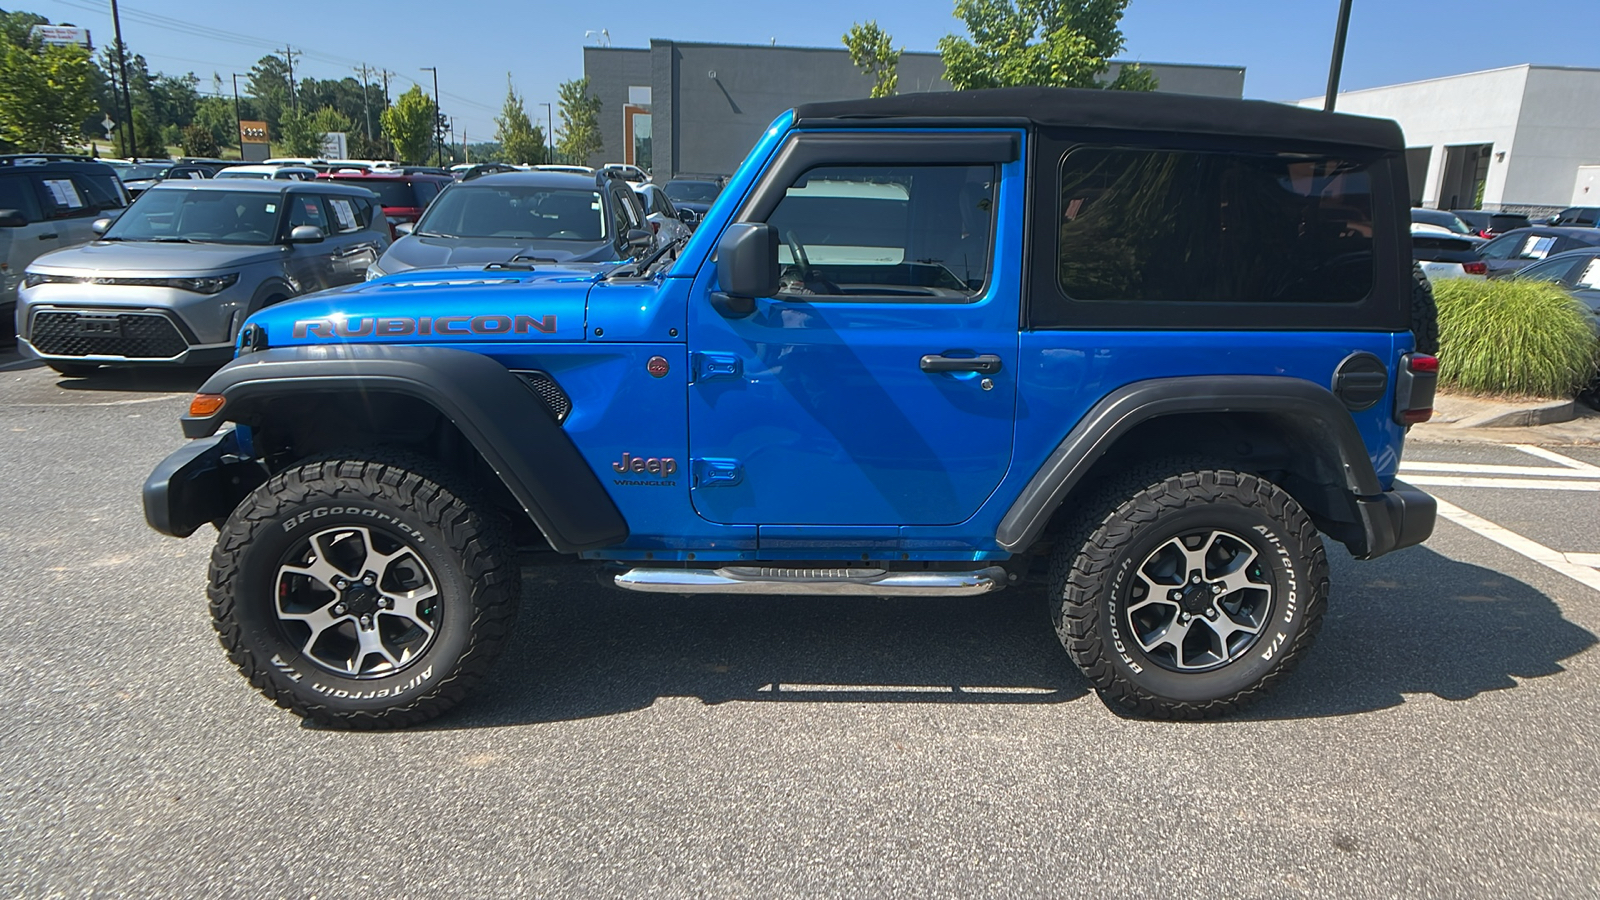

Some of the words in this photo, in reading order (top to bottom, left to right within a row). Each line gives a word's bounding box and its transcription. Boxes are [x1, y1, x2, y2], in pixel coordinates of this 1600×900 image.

[293, 315, 557, 338] RUBICON
[612, 452, 677, 478] Jeep
[282, 506, 425, 542] BFGoodrich
[1252, 524, 1297, 623] All-Terrain
[1108, 558, 1144, 675] BFGoodrich
[1261, 632, 1287, 661] T/A
[270, 653, 303, 684] T/A
[311, 664, 433, 699] All-Terrain
